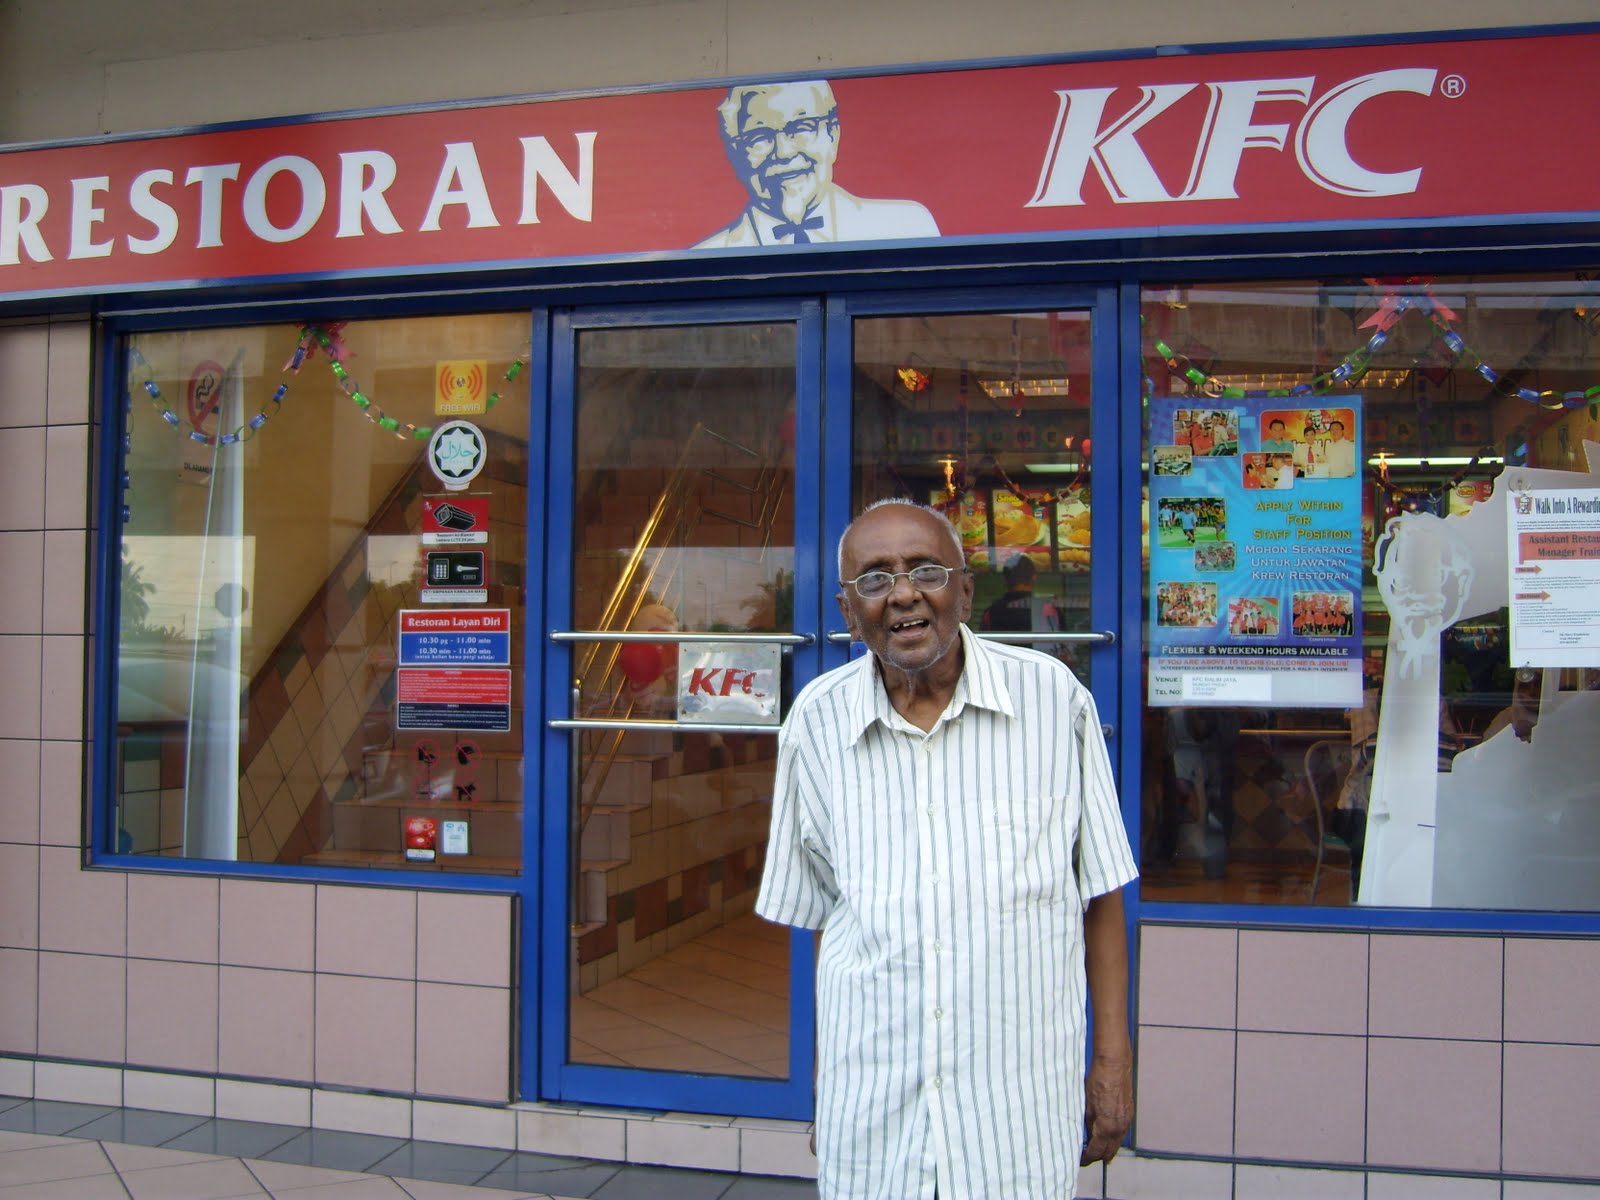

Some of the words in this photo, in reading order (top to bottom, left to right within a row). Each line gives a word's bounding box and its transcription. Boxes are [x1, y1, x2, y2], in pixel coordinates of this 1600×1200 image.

[1023, 68, 1438, 208] KFC
[0, 131, 598, 266] RESTORAN
[1256, 501, 1293, 511] APPLY
[1298, 500, 1343, 511] WITHIN
[1535, 497, 1551, 514] Walk
[1552, 497, 1566, 514] Into
[1566, 497, 1572, 514] A
[1286, 514, 1312, 525] FOR
[1253, 529, 1290, 540] STAFF
[1296, 529, 1352, 539] POSITION
[1529, 534, 1569, 544] Assistant
[1245, 545, 1287, 554] MOHON
[1292, 545, 1353, 554] SEKARANG
[1538, 548, 1576, 557] Manager
[1251, 558, 1290, 567] UNTUK
[1294, 558, 1346, 567] JAWATAN
[1252, 571, 1285, 580] KREW
[1289, 571, 1349, 580] RESTORAN
[408, 617, 450, 627] Restoran
[452, 617, 480, 628] Layan
[483, 617, 501, 627] Diri
[1162, 645, 1205, 655] FLEXIBLE
[1208, 645, 1217, 655] &
[1218, 647, 1264, 655] WEEKEND
[1265, 647, 1298, 656] HOURS
[1299, 648, 1349, 656] AVAILABLE
